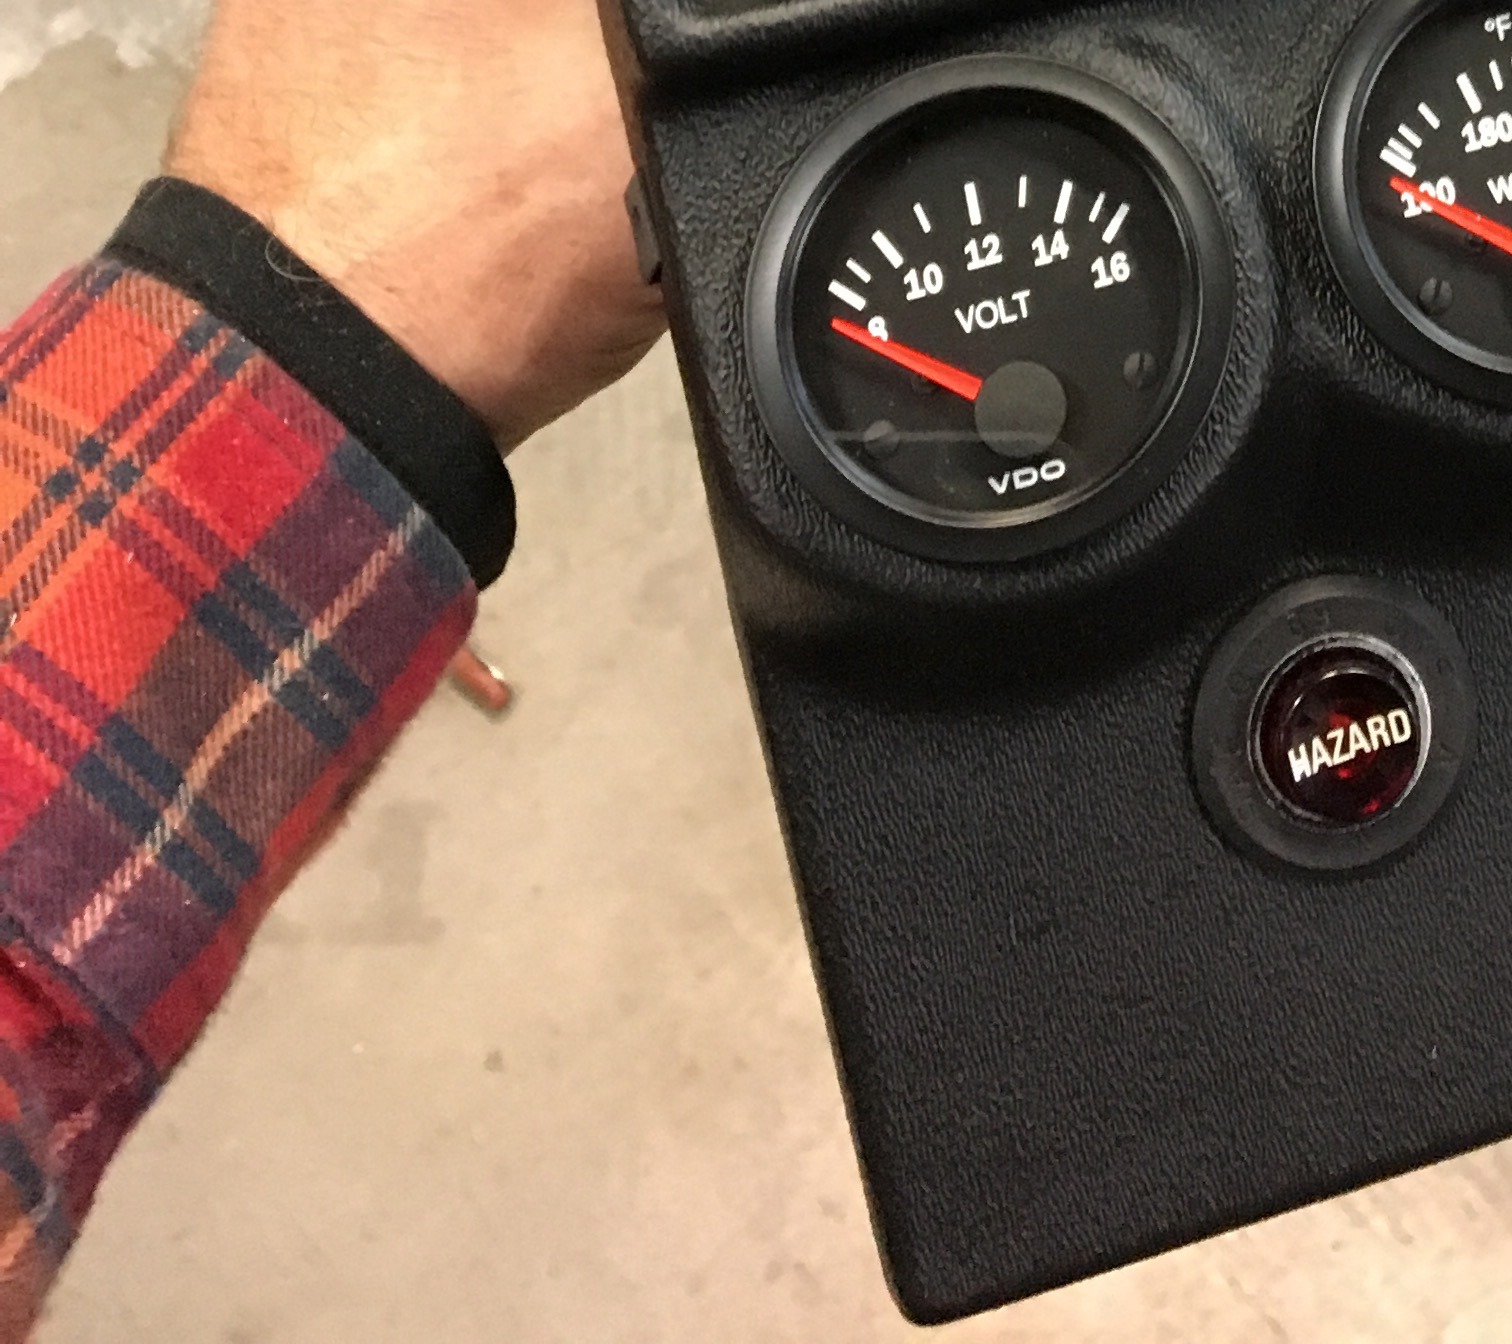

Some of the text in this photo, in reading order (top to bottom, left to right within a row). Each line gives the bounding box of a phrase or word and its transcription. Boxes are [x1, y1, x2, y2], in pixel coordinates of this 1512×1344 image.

[903, 262, 944, 301] 10
[964, 233, 1003, 271] 12
[1031, 228, 1070, 267] 14
[1090, 251, 1131, 289] 16
[954, 289, 1031, 334] VOLT
[988, 459, 1066, 494] VDO
[1287, 708, 1412, 783] HAZARD
